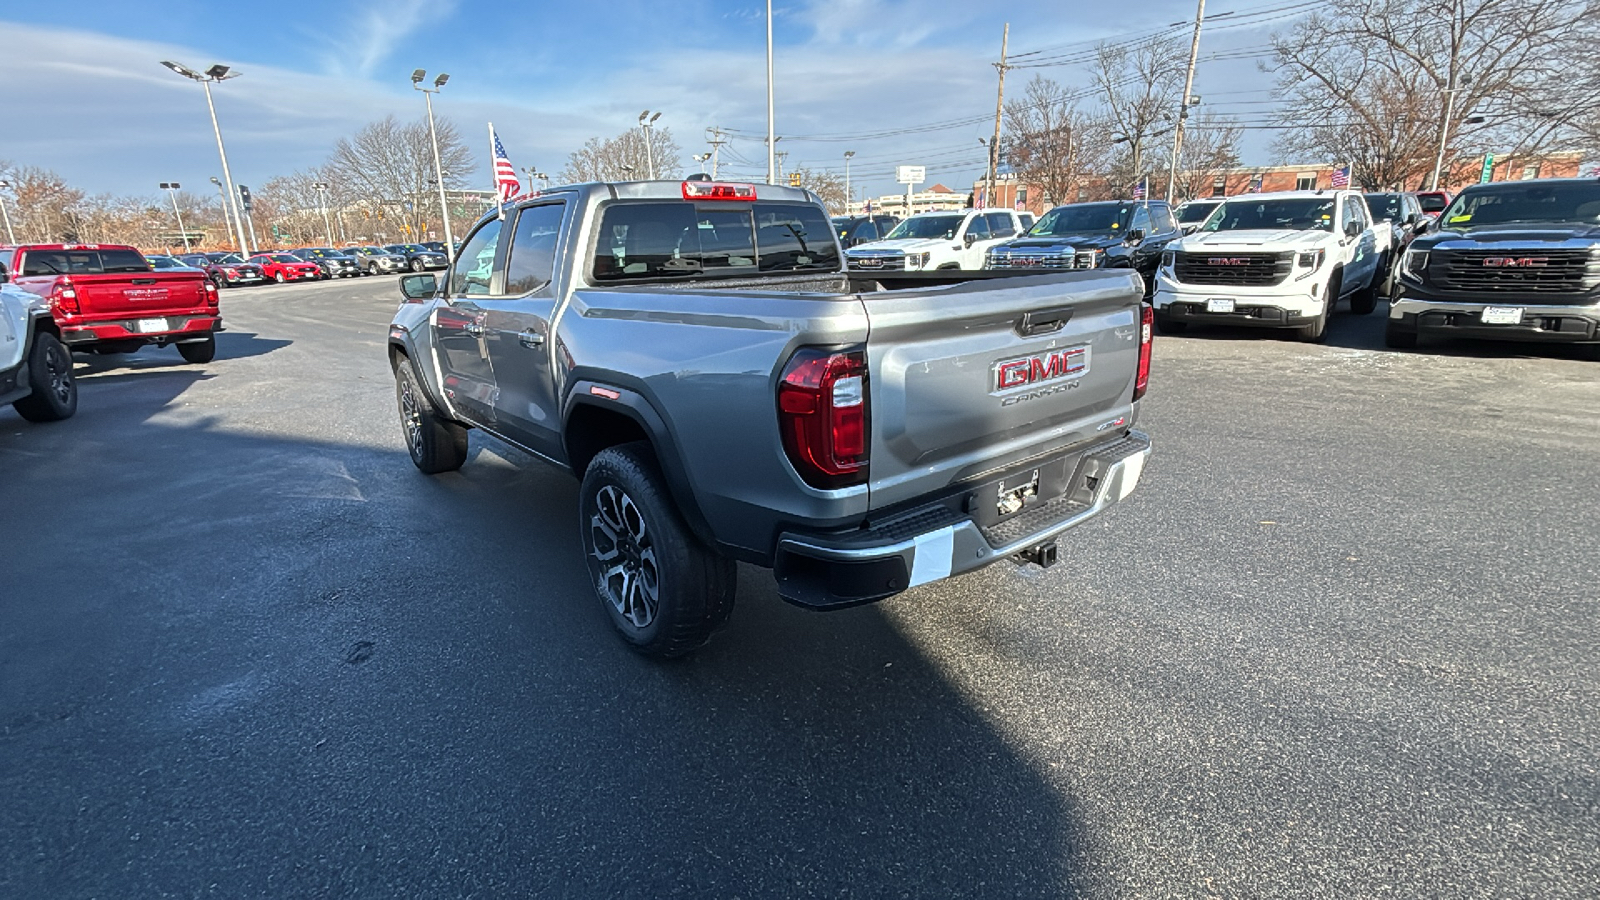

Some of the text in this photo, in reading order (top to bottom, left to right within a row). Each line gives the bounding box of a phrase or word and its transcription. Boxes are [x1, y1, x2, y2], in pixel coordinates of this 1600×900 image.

[1207, 257, 1251, 266] GMC
[1482, 257, 1549, 267] GMC
[998, 347, 1086, 390] GMC
[1001, 380, 1080, 407] CANYON
